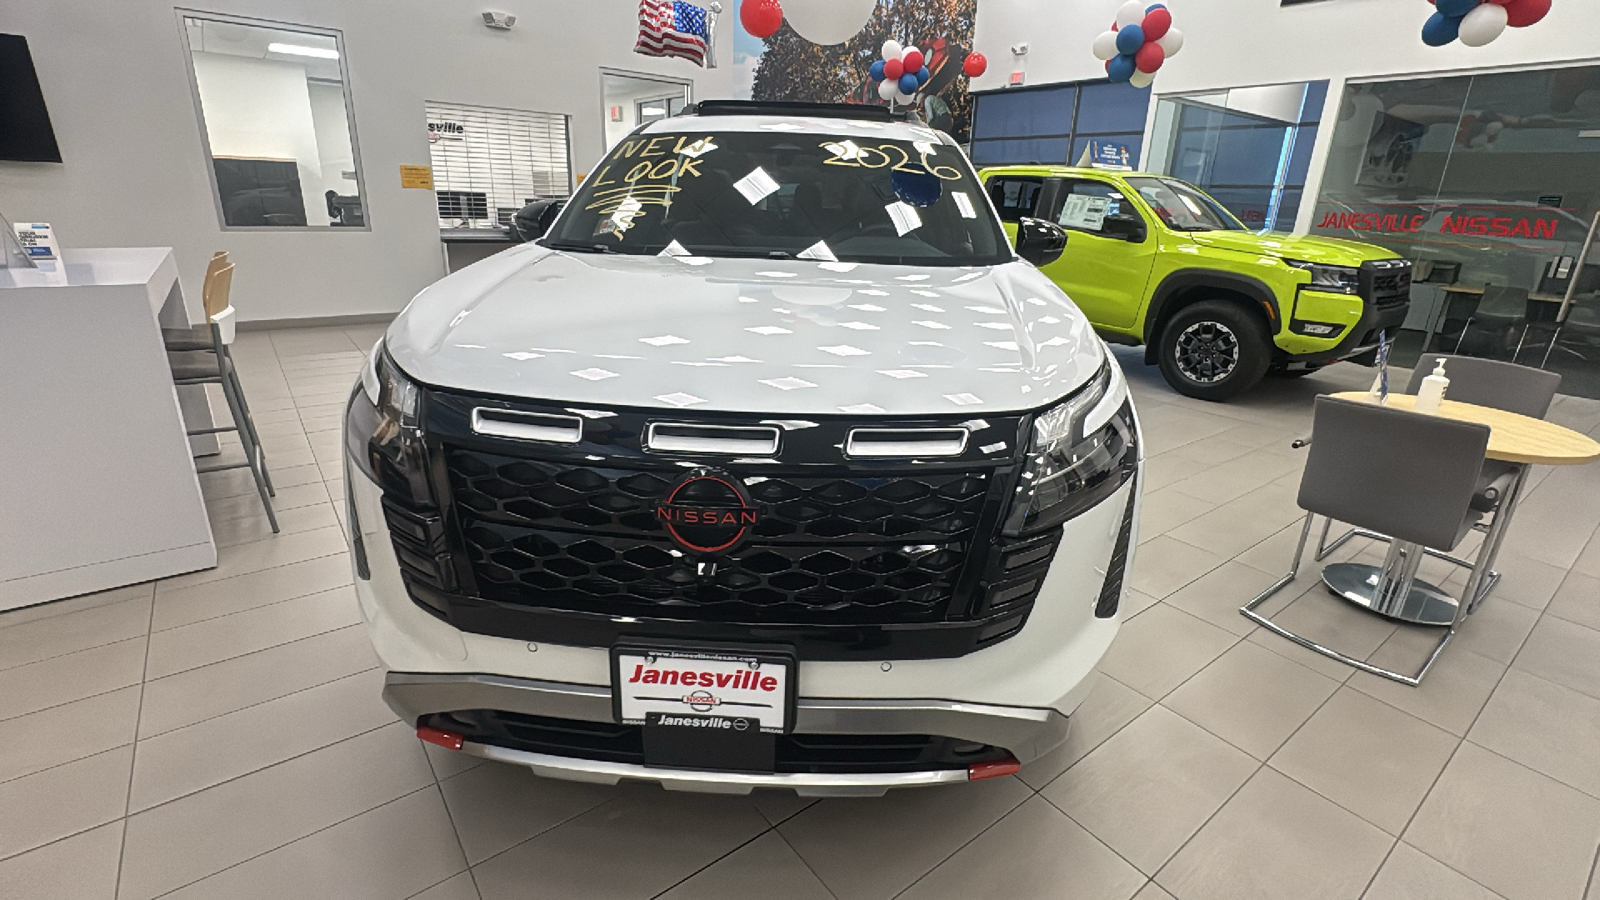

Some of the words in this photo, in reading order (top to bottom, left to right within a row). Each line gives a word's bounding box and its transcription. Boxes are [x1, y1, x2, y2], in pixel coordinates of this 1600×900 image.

[613, 136, 714, 160] NEW
[592, 159, 704, 187] LOOK
[818, 142, 962, 180] 2026
[1317, 212, 1424, 233] JANESVILLE
[1440, 216, 1558, 238] NISSAN
[657, 506, 756, 524] NISSAN
[629, 664, 778, 692] Janesville
[686, 696, 716, 704] NISSAN
[658, 715, 731, 729] Janesville
